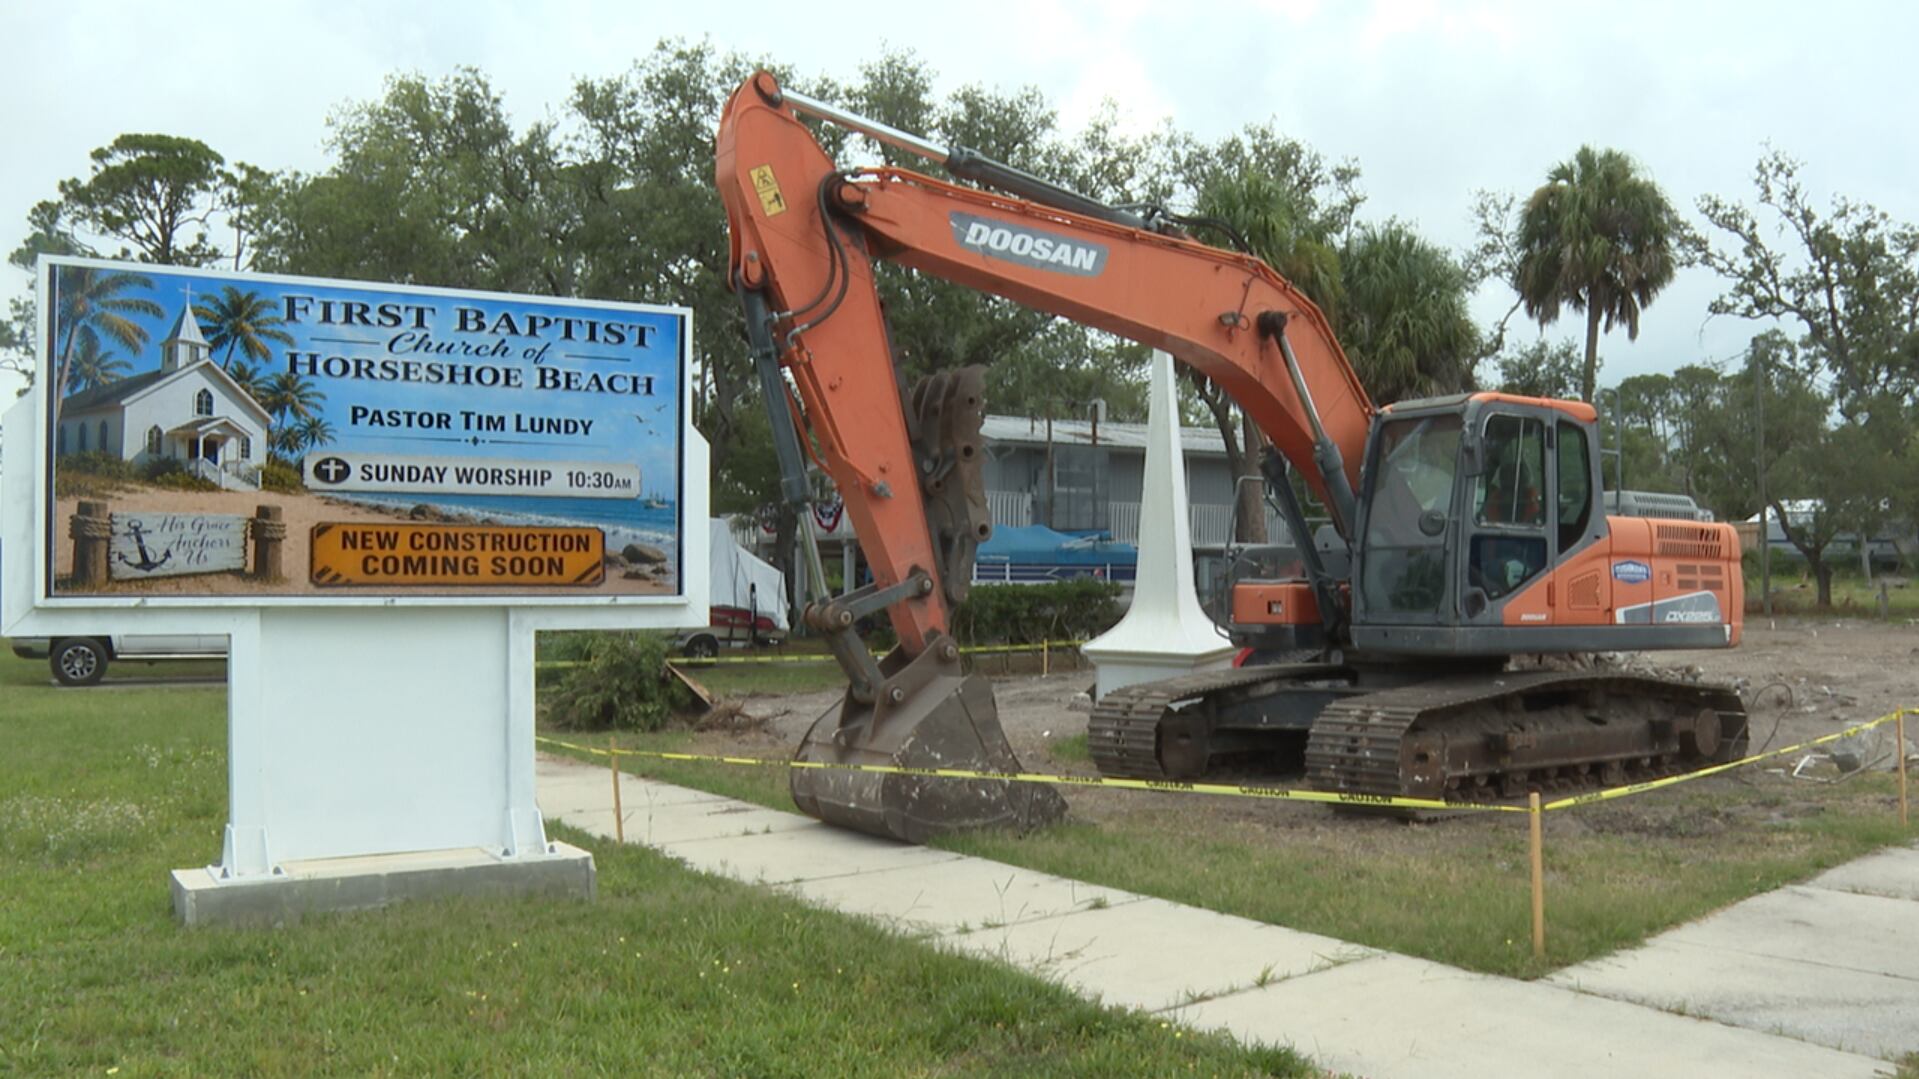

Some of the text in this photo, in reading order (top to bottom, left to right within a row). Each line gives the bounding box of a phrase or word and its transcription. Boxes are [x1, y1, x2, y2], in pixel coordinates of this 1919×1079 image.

[965, 221, 1097, 271] DOOSAN
[282, 294, 657, 348] FIRST BAPTIST
[388, 331, 552, 365] Church of
[286, 351, 656, 396] HORSESHOE BEACH
[351, 405, 594, 436] PASTOR TIM LUNDY
[360, 463, 448, 484] SUNDAY
[455, 466, 552, 487] WORSHIP
[191, 516, 231, 534] Grace
[341, 530, 590, 552] NEW CONSTRUCTION
[361, 554, 565, 576] COMING SOON
[1239, 785, 1290, 798] CAUTION
[1338, 792, 1392, 804] CAUTION
